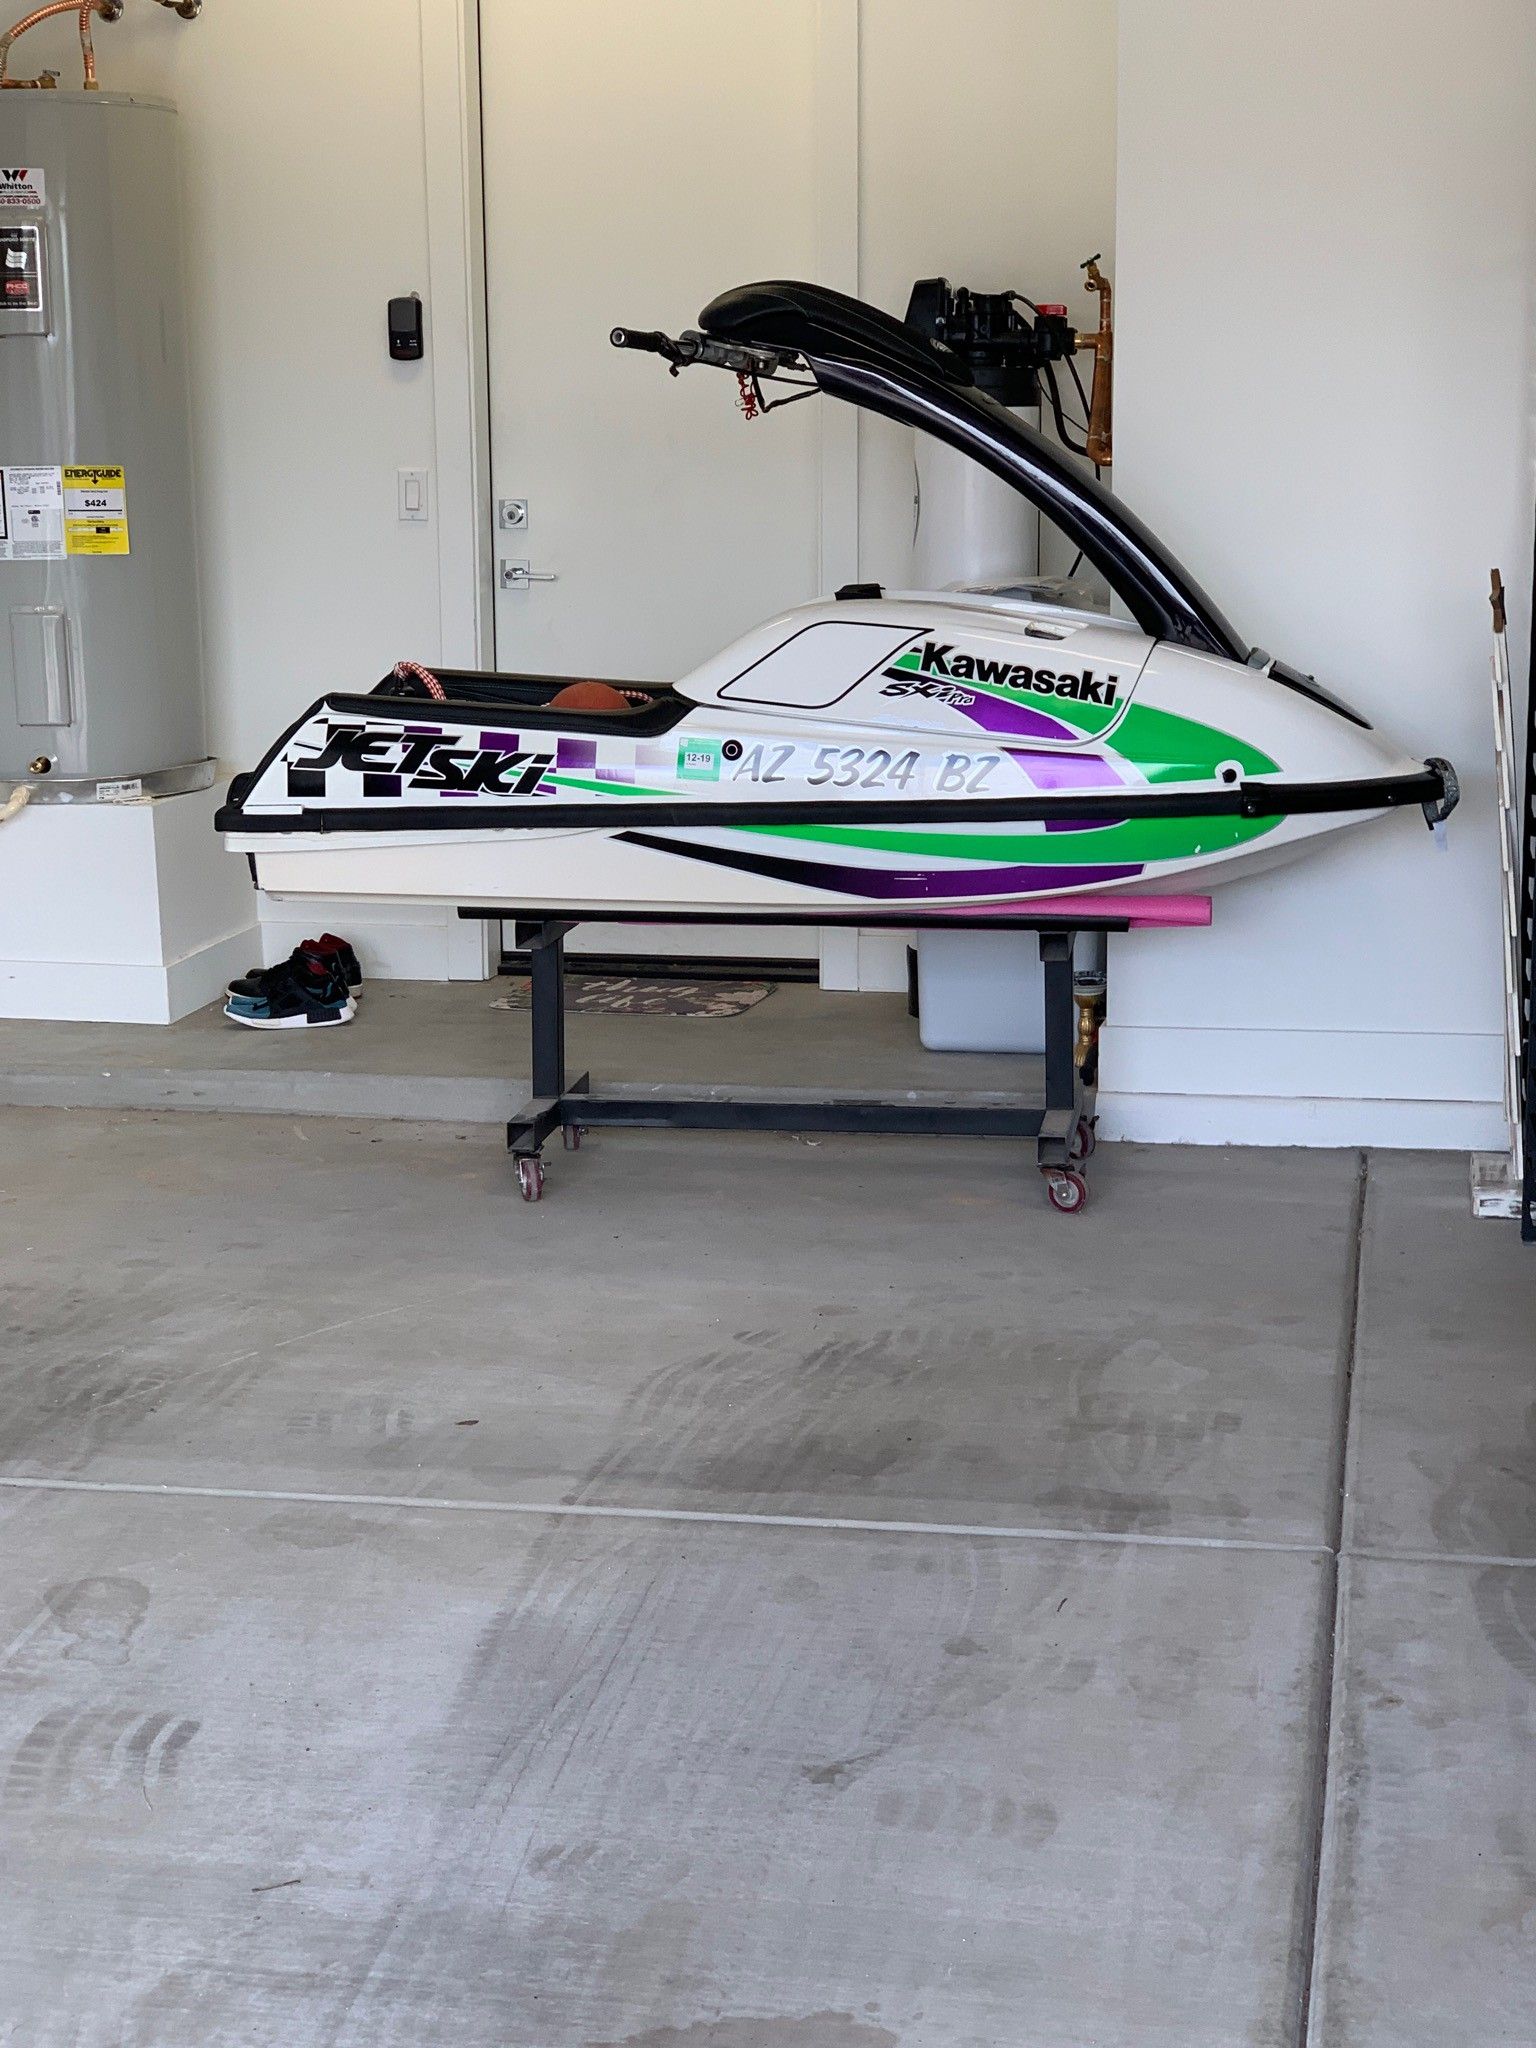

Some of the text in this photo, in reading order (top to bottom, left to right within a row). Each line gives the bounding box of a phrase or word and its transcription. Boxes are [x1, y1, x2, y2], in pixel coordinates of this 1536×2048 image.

[84, 499, 107, 507] $424
[920, 641, 1118, 706] Kawasaki
[687, 753, 711, 763] 12-19
[732, 744, 1001, 794] AZ 5324 BZ
